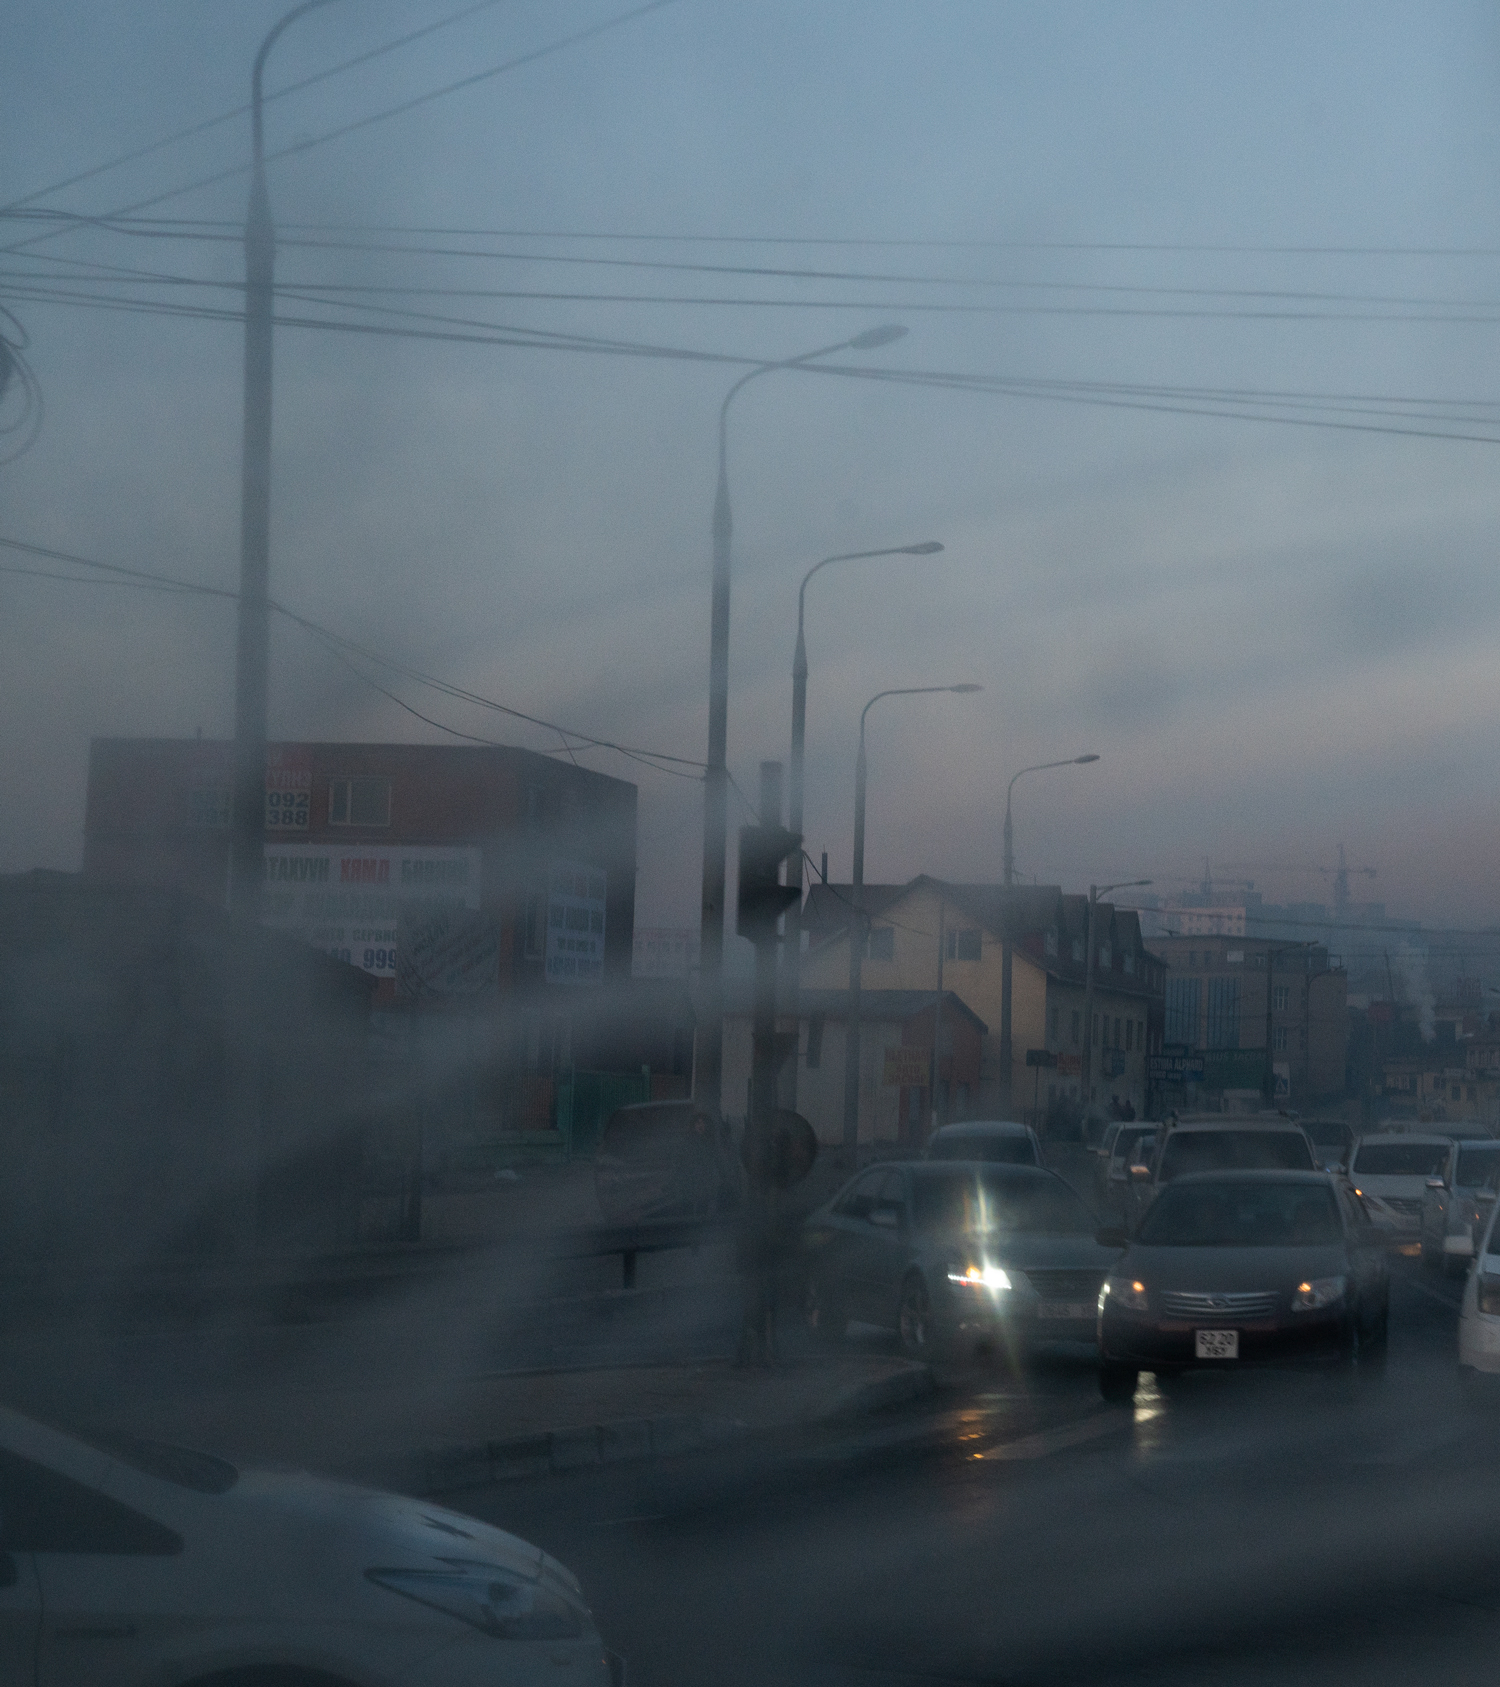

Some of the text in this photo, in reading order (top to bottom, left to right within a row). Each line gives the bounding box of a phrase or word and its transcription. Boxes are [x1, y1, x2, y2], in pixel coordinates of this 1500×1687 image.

[268, 792, 309, 808] 092
[268, 809, 308, 826] 388
[340, 857, 390, 885] ХЯМД
